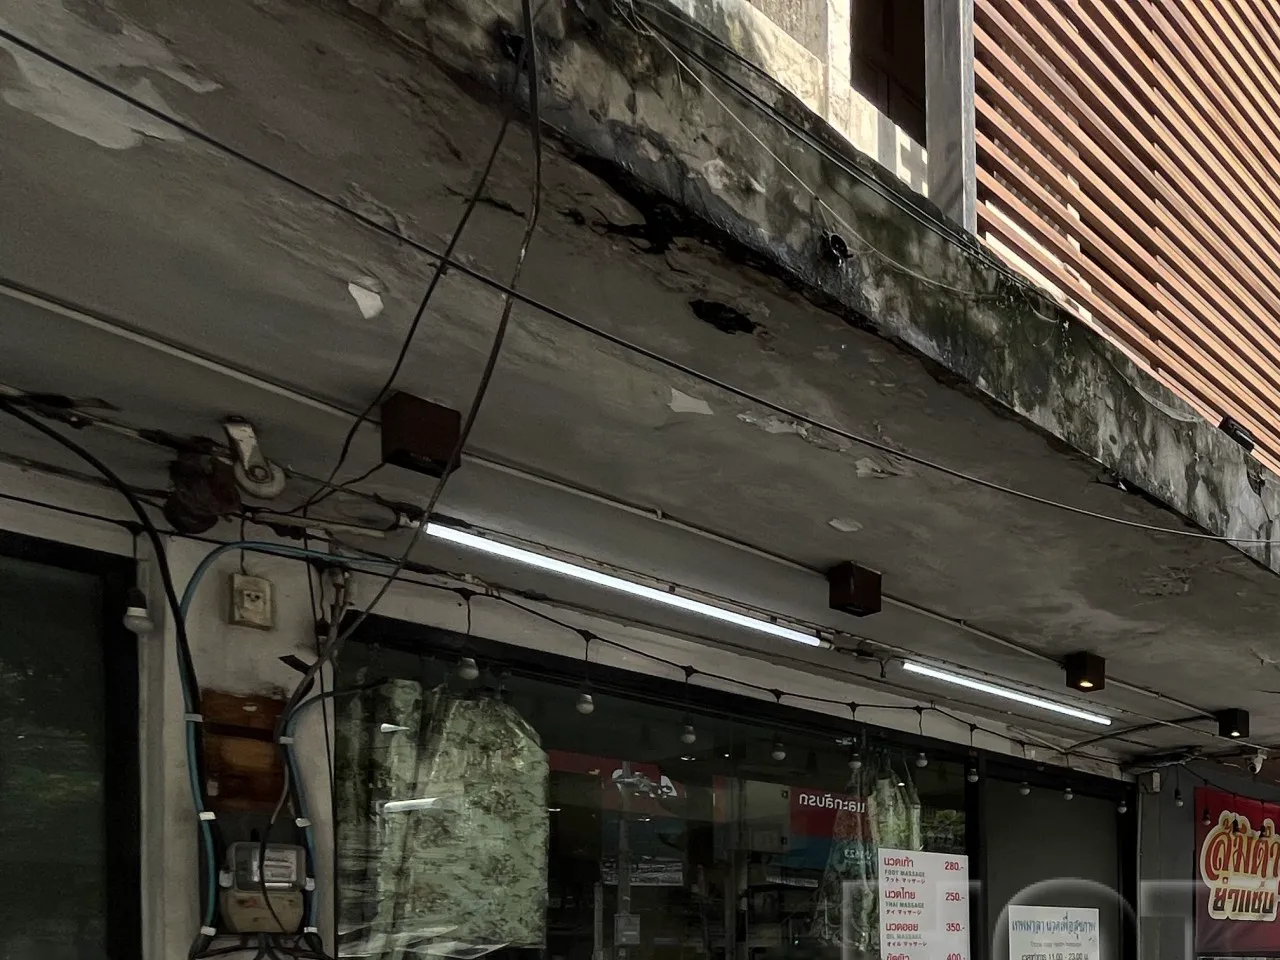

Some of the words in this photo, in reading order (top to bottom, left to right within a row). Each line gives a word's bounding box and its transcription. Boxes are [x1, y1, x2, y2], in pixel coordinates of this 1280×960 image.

[900, 870, 925, 878] MASSAGE
[885, 887, 916, 900] นวดไทย
